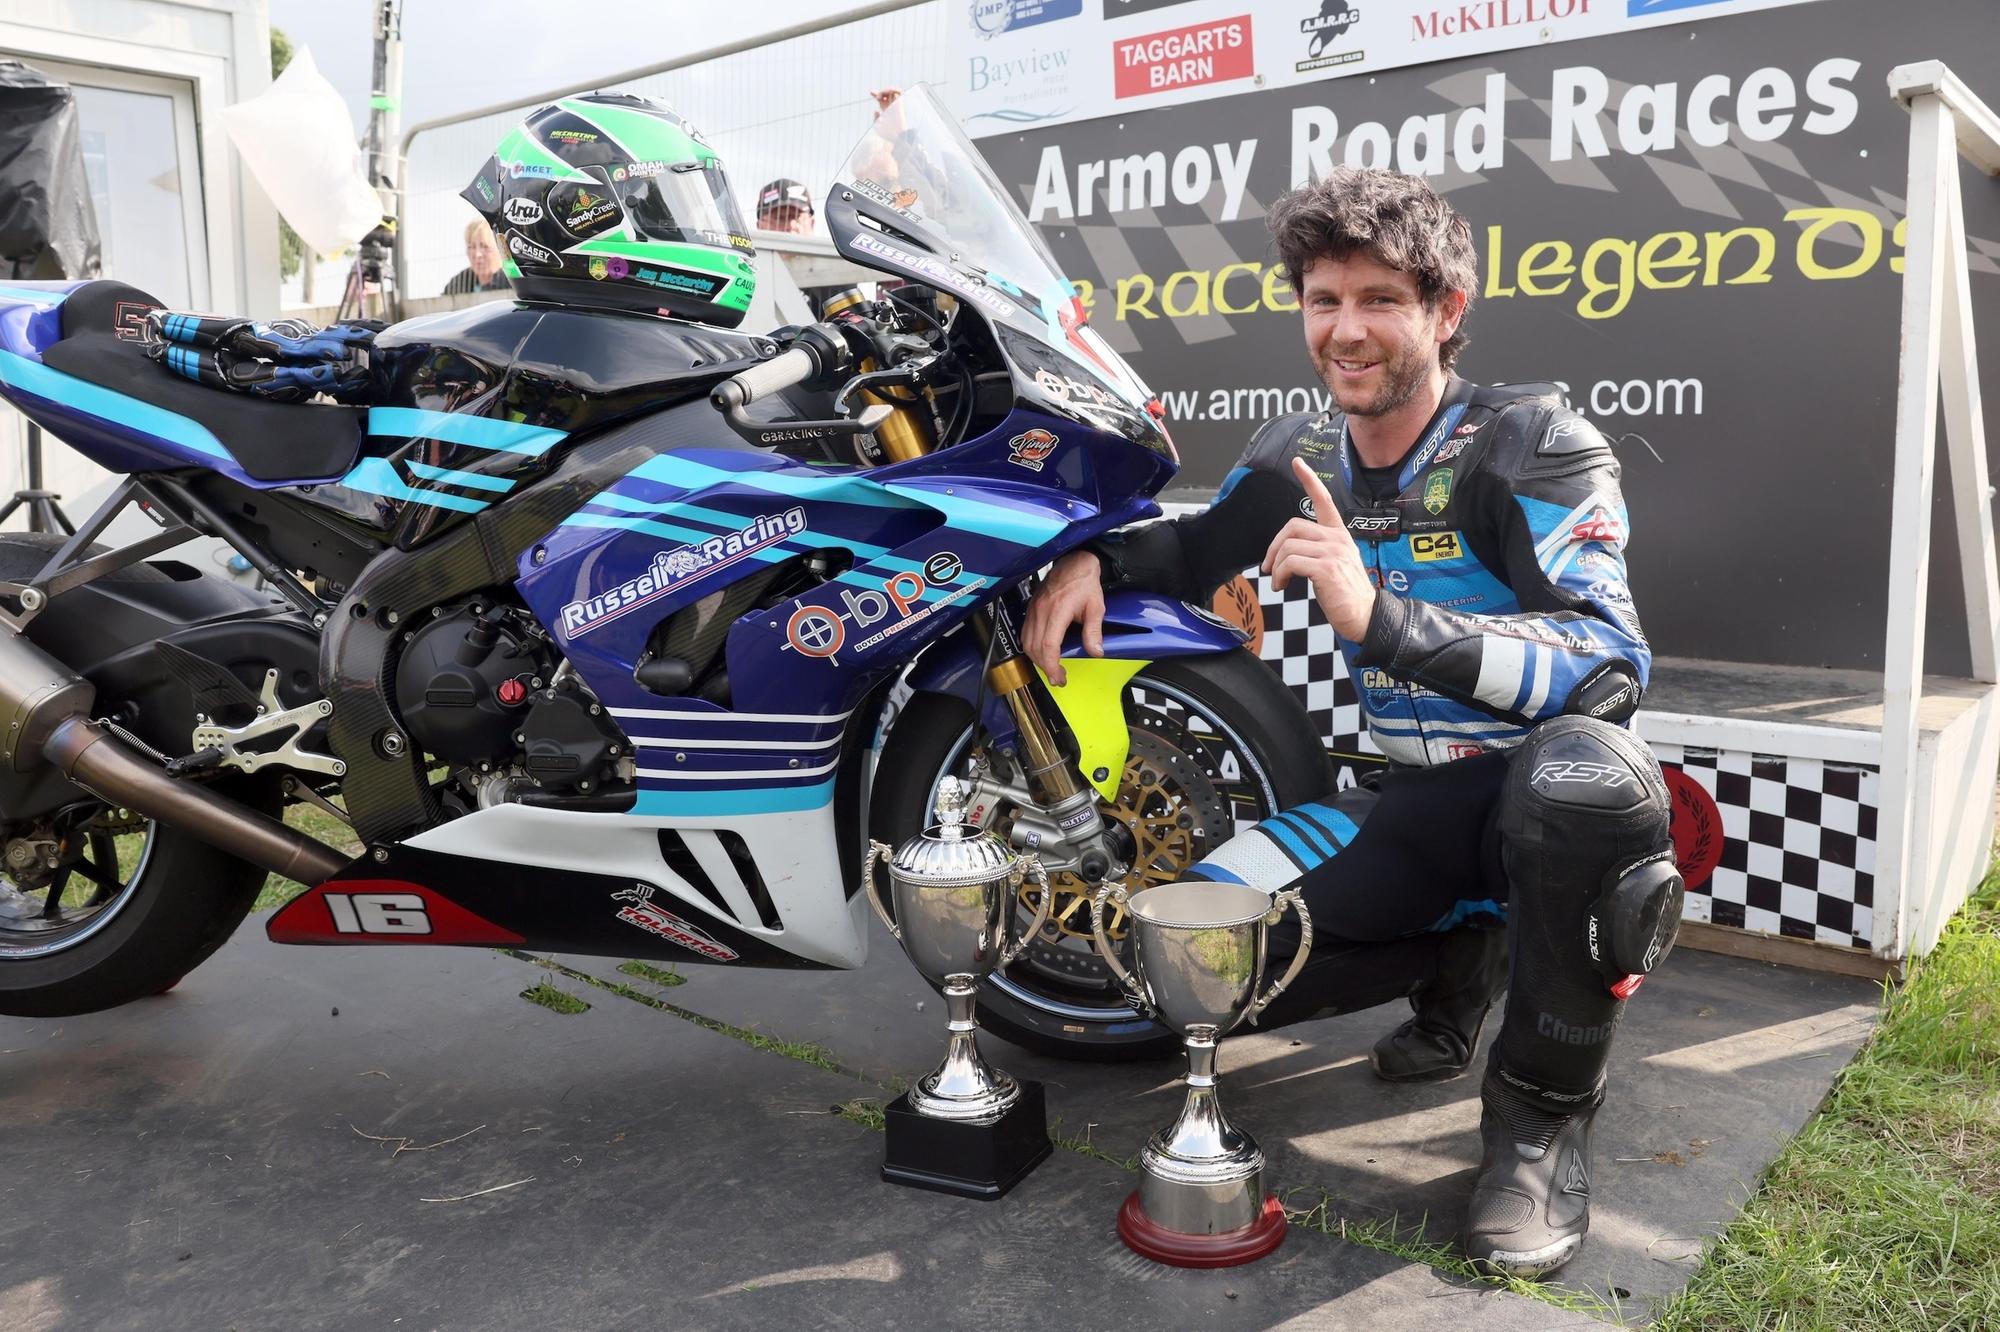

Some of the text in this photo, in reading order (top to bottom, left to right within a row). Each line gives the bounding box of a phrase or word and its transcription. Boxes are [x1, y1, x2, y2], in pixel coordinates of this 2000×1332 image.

[977, 2, 1004, 18] JMP
[1120, 24, 1242, 67] TAGGARTS
[968, 48, 1070, 92] Bayview
[1150, 56, 1213, 88] BARN
[1297, 56, 1343, 71] SUPPORTERS
[1029, 58, 1862, 222] Armoy Road Races
[514, 165, 553, 174] TARGET
[504, 199, 541, 218] Arai
[566, 200, 617, 229] SandyCreek
[522, 242, 551, 260] CASEY
[855, 234, 1015, 316] Russell Racing
[1012, 433, 1060, 454] Vinyl
[1413, 416, 1448, 475] RST
[1019, 457, 1042, 471] SIGNS
[1346, 516, 1399, 531] RST
[1413, 533, 1457, 554] C4
[1435, 551, 1455, 559] ENERGY
[565, 508, 806, 631] Russell Racing
[840, 551, 963, 629] bpe
[855, 632, 884, 652] BOYCE
[884, 608, 930, 638] PRECISION
[930, 578, 987, 612] ENGINEERING
[1589, 685, 1631, 717] RST
[1530, 761, 1638, 787] RST
[1060, 808, 1093, 830] MAXTON
[322, 891, 433, 935] 16
[621, 906, 737, 961] TOLERTON
[1588, 915, 1601, 962] FACTORY
